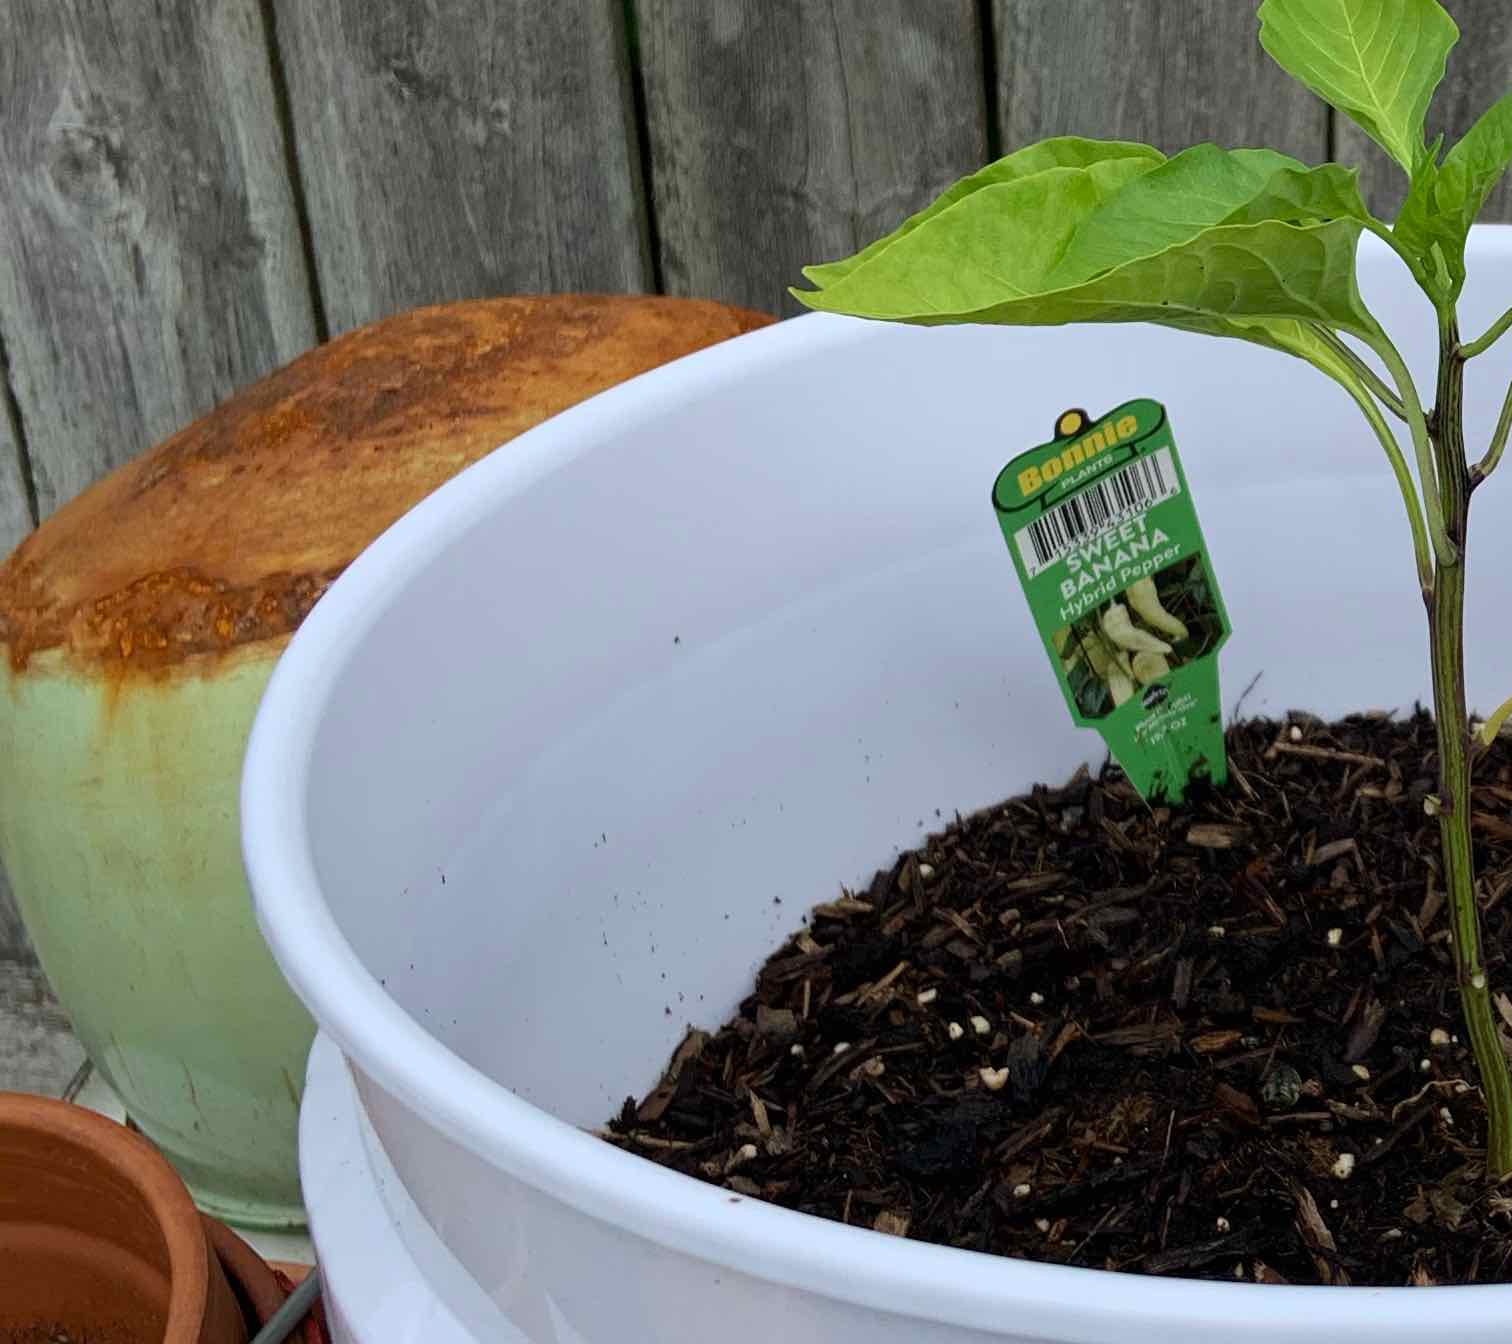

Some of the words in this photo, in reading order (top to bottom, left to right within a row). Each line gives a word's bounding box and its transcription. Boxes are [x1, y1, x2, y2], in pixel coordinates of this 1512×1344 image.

[1017, 415, 1138, 497] Bonnie
[1061, 454, 1114, 489] PLANTS
[1059, 527, 1170, 602] BANANA
[1066, 513, 1148, 573] SWEET
[1059, 574, 1117, 622] Hybrid
[1119, 544, 1181, 584] Pepper
